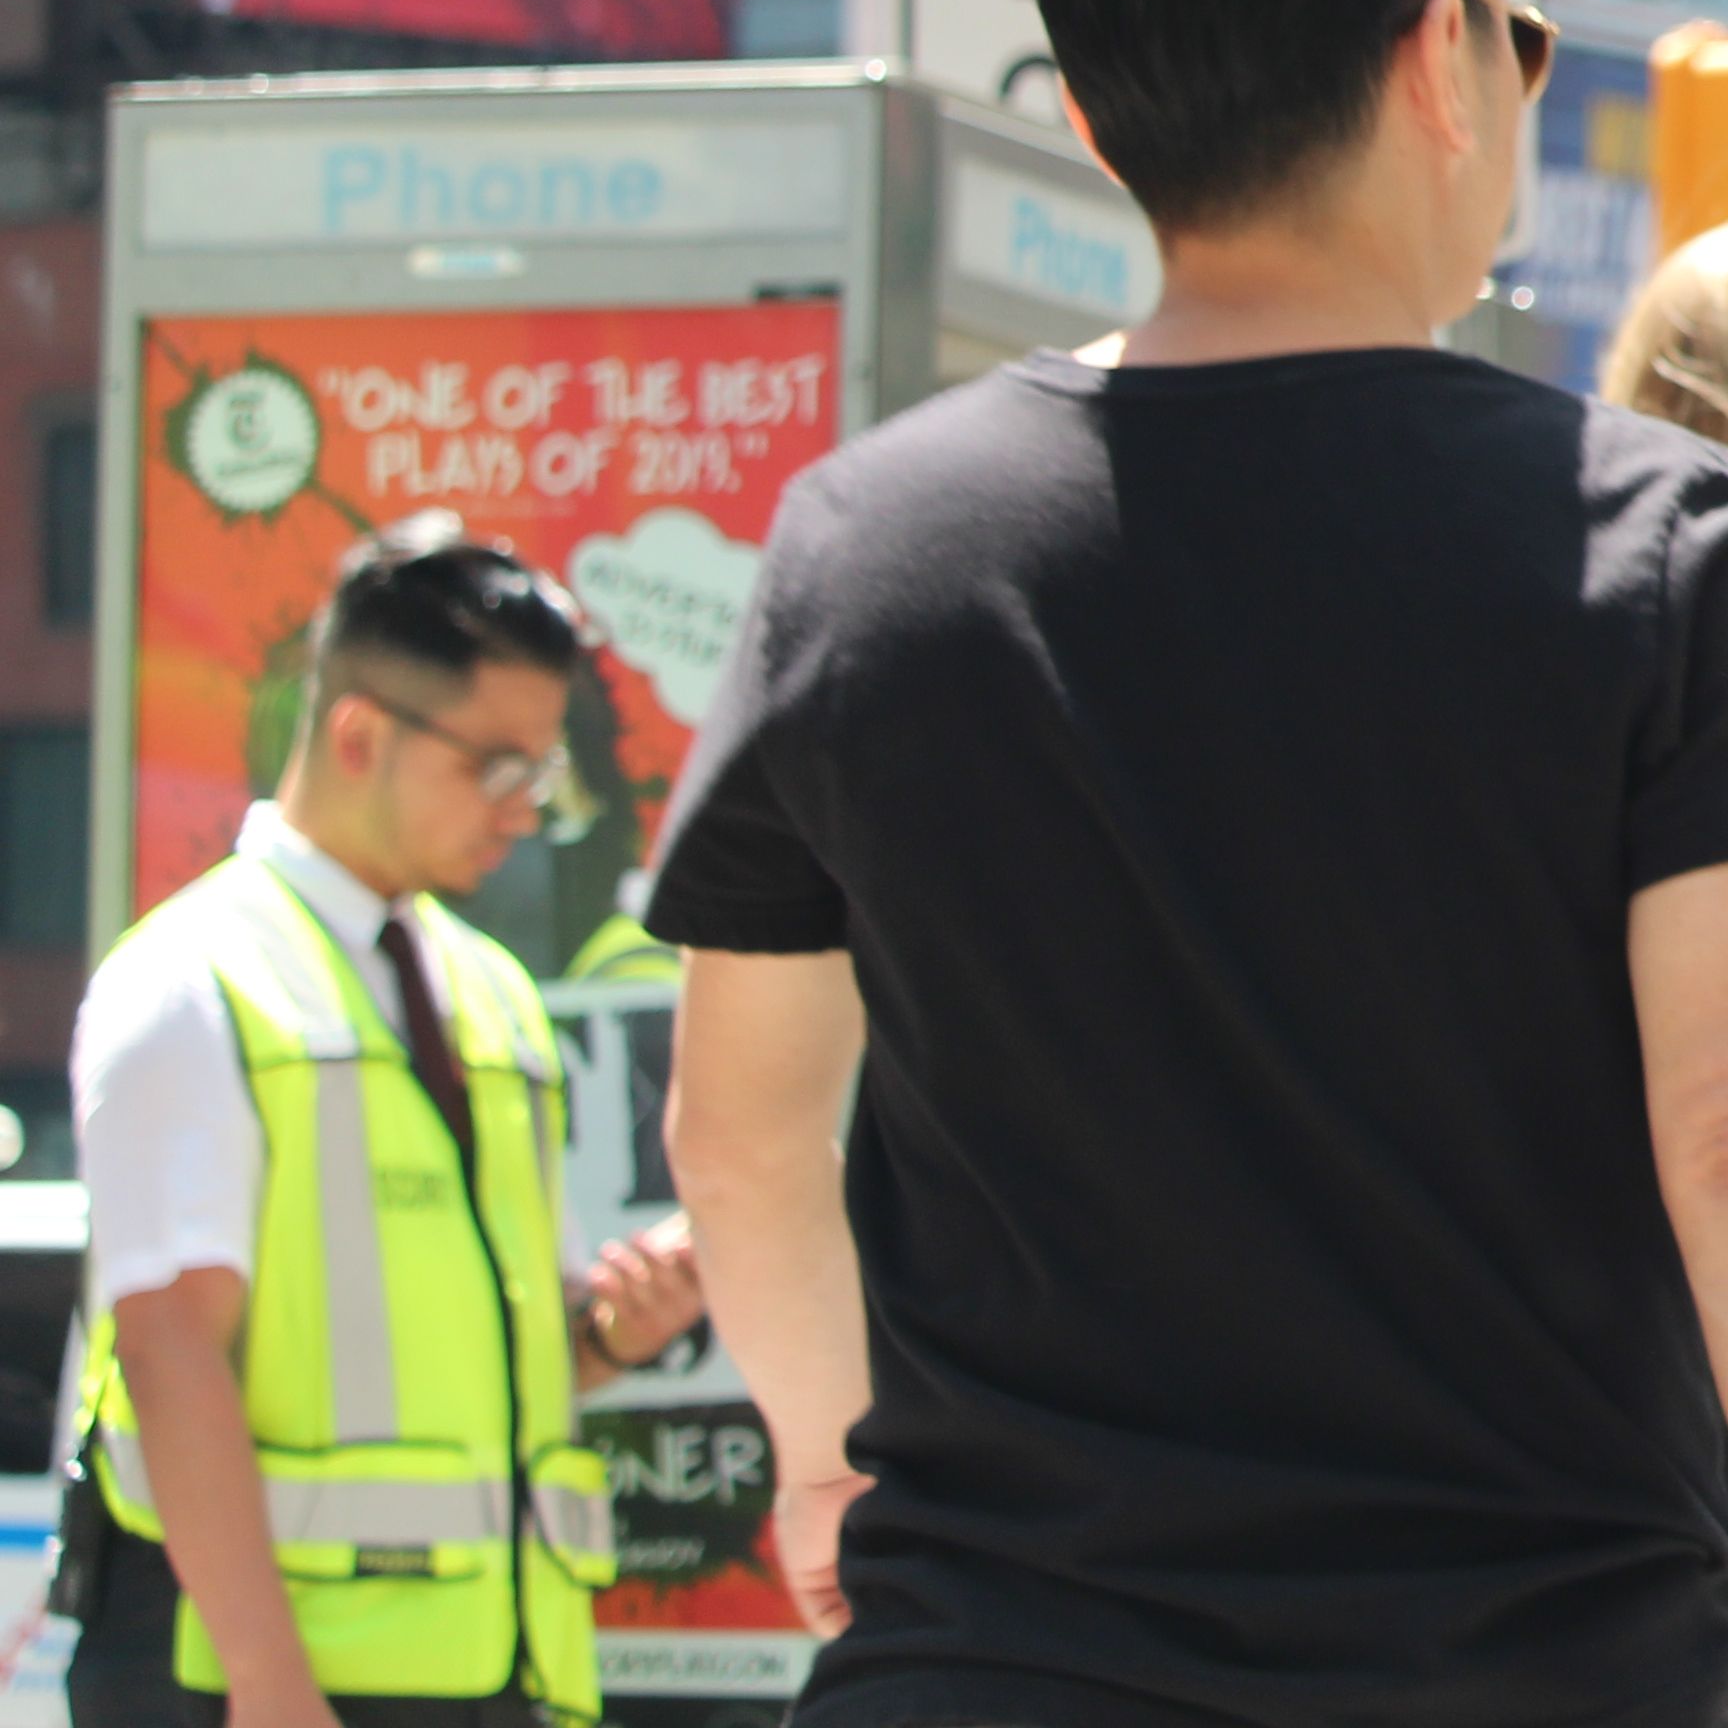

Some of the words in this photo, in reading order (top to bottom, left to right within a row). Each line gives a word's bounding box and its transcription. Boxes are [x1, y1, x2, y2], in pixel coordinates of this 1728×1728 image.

[322, 145, 664, 234] Phone
[1010, 195, 1130, 309] Phone
[483, 360, 572, 433] OF
[583, 355, 691, 429] THE
[697, 351, 829, 430] BEST
[364, 429, 525, 500] PLAYS
[528, 426, 623, 499] OF
